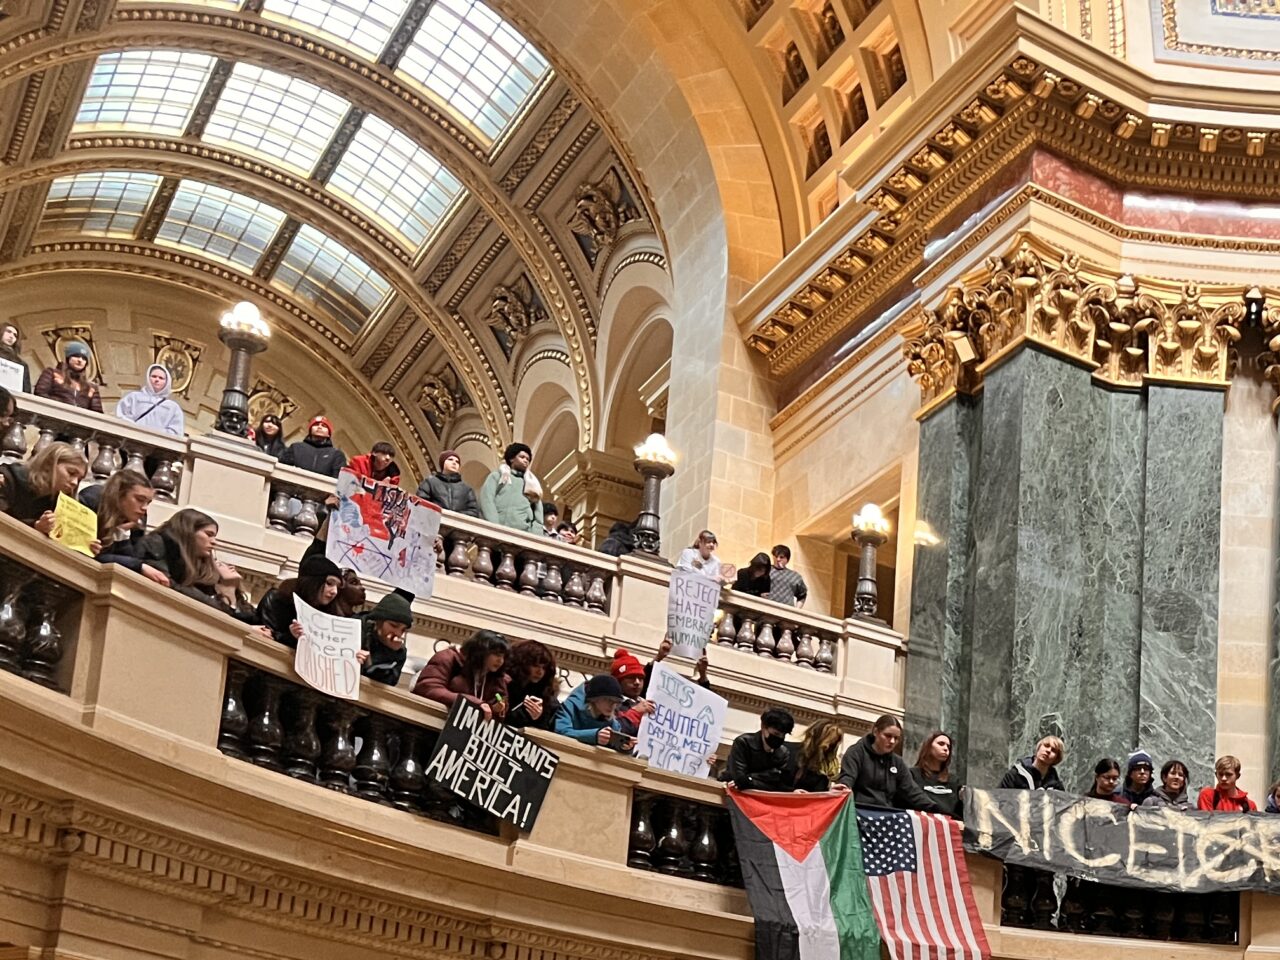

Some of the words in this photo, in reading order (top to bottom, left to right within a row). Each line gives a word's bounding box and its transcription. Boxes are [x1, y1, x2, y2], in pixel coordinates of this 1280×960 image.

[674, 598, 707, 620] HATE
[675, 577, 720, 608] REJECT
[697, 705, 715, 725] A
[453, 698, 558, 779] IMMIGRANTS
[648, 722, 665, 739] DAY
[666, 731, 679, 747] TO
[683, 738, 711, 755] MELT
[463, 735, 523, 788] BUILT
[425, 744, 532, 828] AMERICA!
